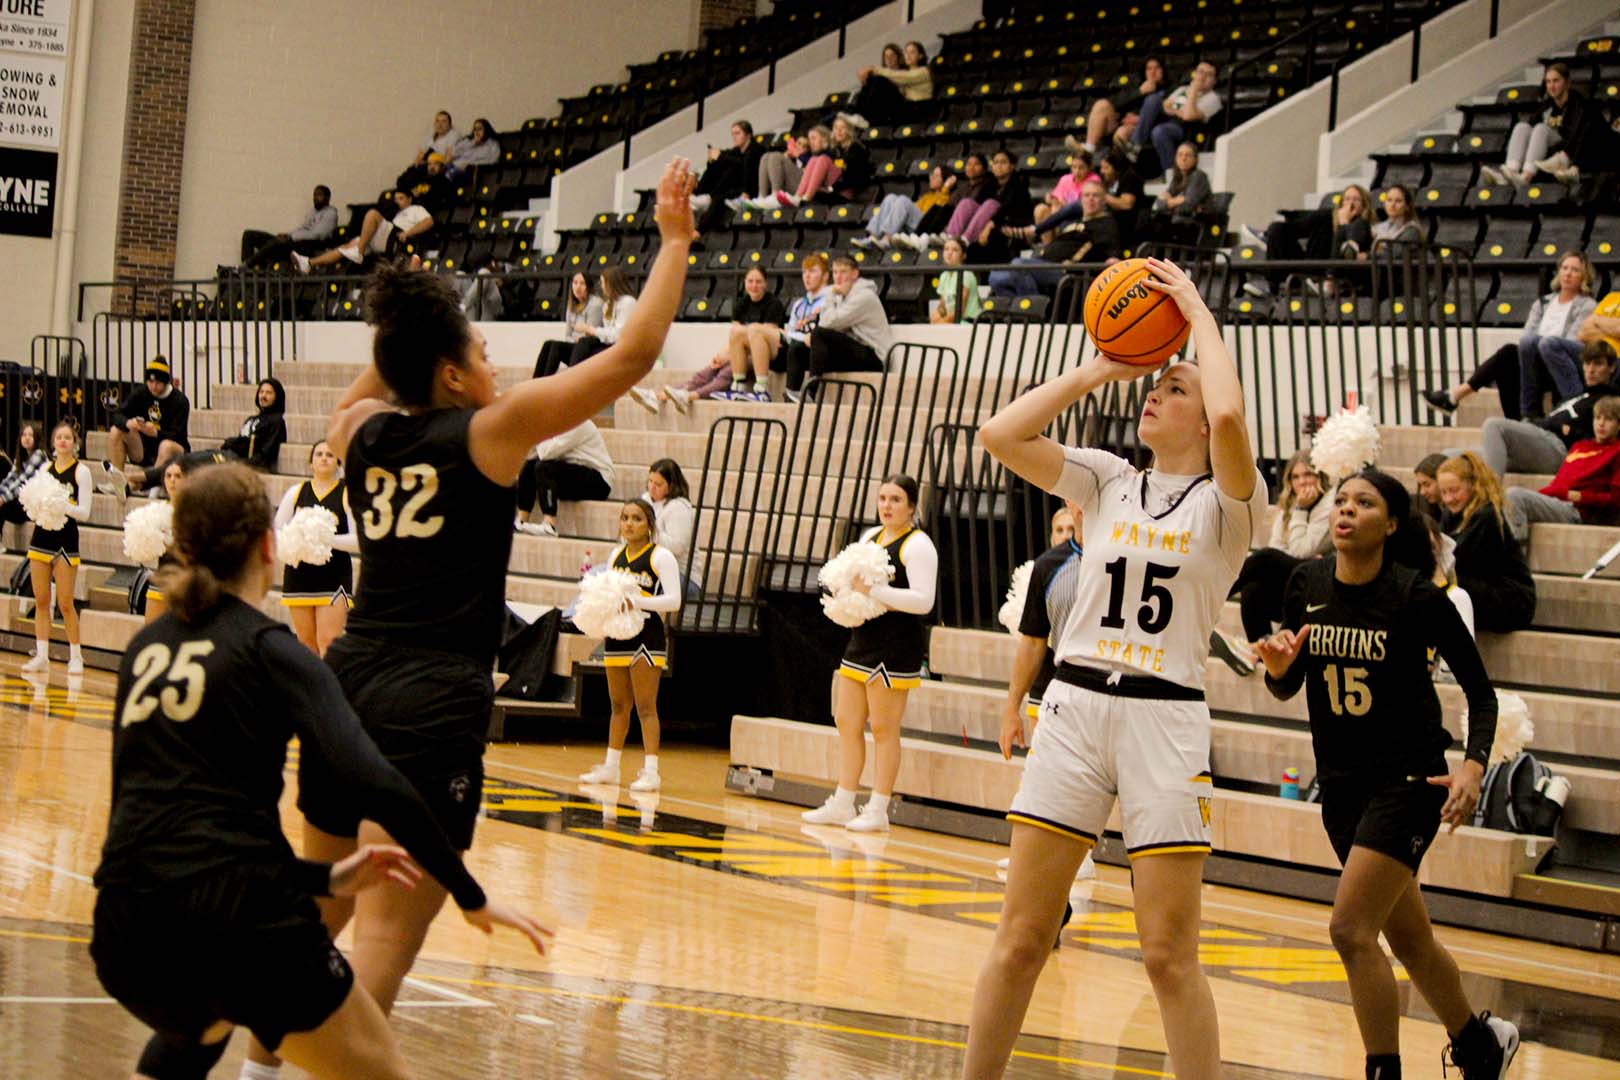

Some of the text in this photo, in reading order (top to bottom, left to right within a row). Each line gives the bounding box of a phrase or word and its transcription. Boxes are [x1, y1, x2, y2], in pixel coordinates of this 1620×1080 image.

[11, 23, 34, 35] Since
[0, 68, 56, 88] OWING &
[2, 86, 40, 102] SNOW
[0, 101, 48, 119] EMOVAL
[1107, 271, 1163, 320] lson
[362, 463, 445, 540] 32
[1109, 521, 1194, 555] WAYNE
[1100, 556, 1181, 634] 15
[1095, 639, 1166, 673] STATE
[1309, 623, 1387, 662] BRUINS
[121, 639, 215, 728] 25
[1323, 663, 1373, 716] 15
